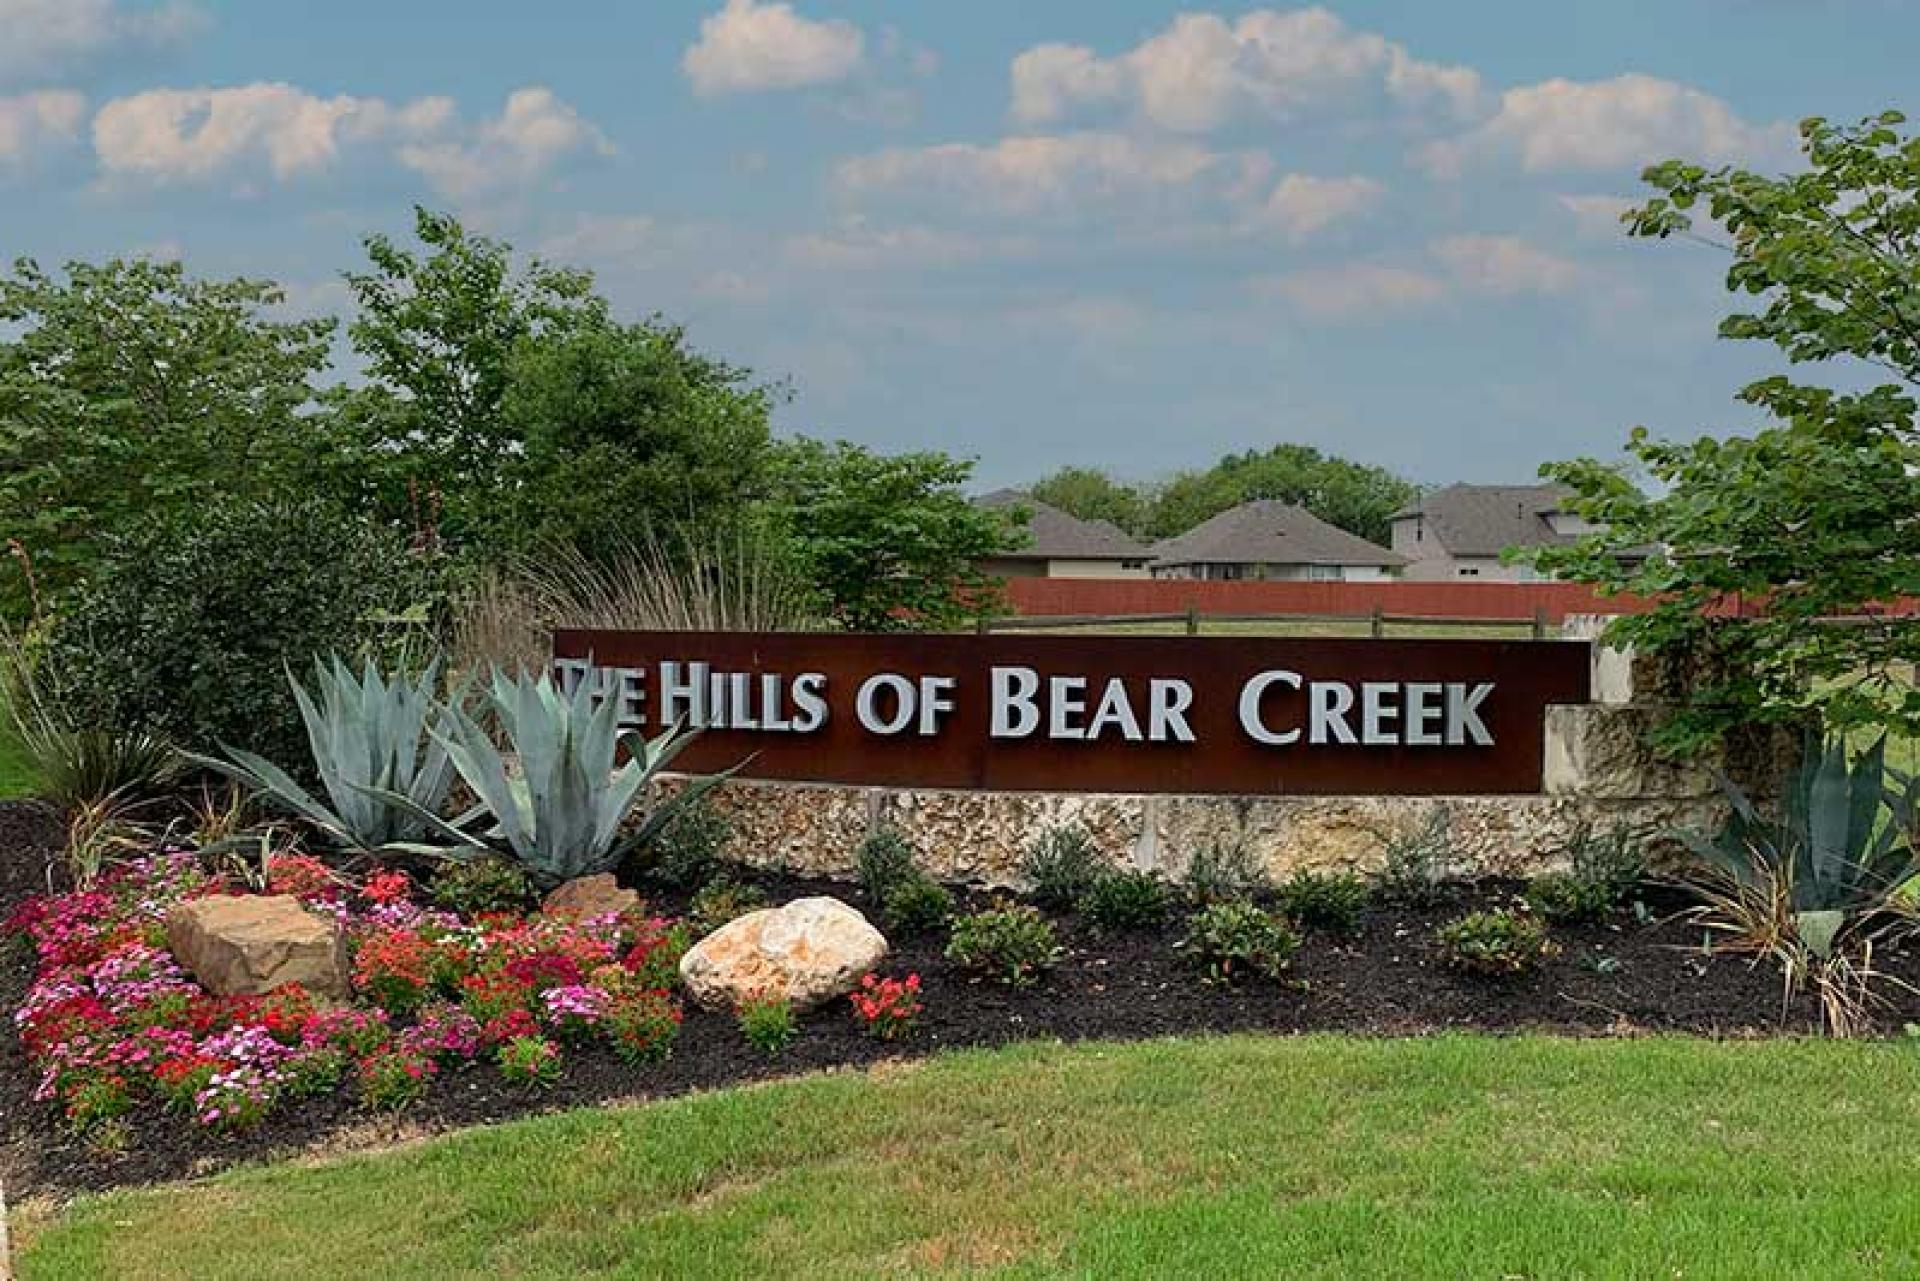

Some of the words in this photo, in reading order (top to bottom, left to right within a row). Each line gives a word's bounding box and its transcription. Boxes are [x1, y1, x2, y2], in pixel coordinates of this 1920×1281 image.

[659, 660, 828, 732] HILLS
[855, 673, 957, 735] OF
[990, 666, 1196, 742] BEAR
[1239, 670, 1496, 746] CREEK
